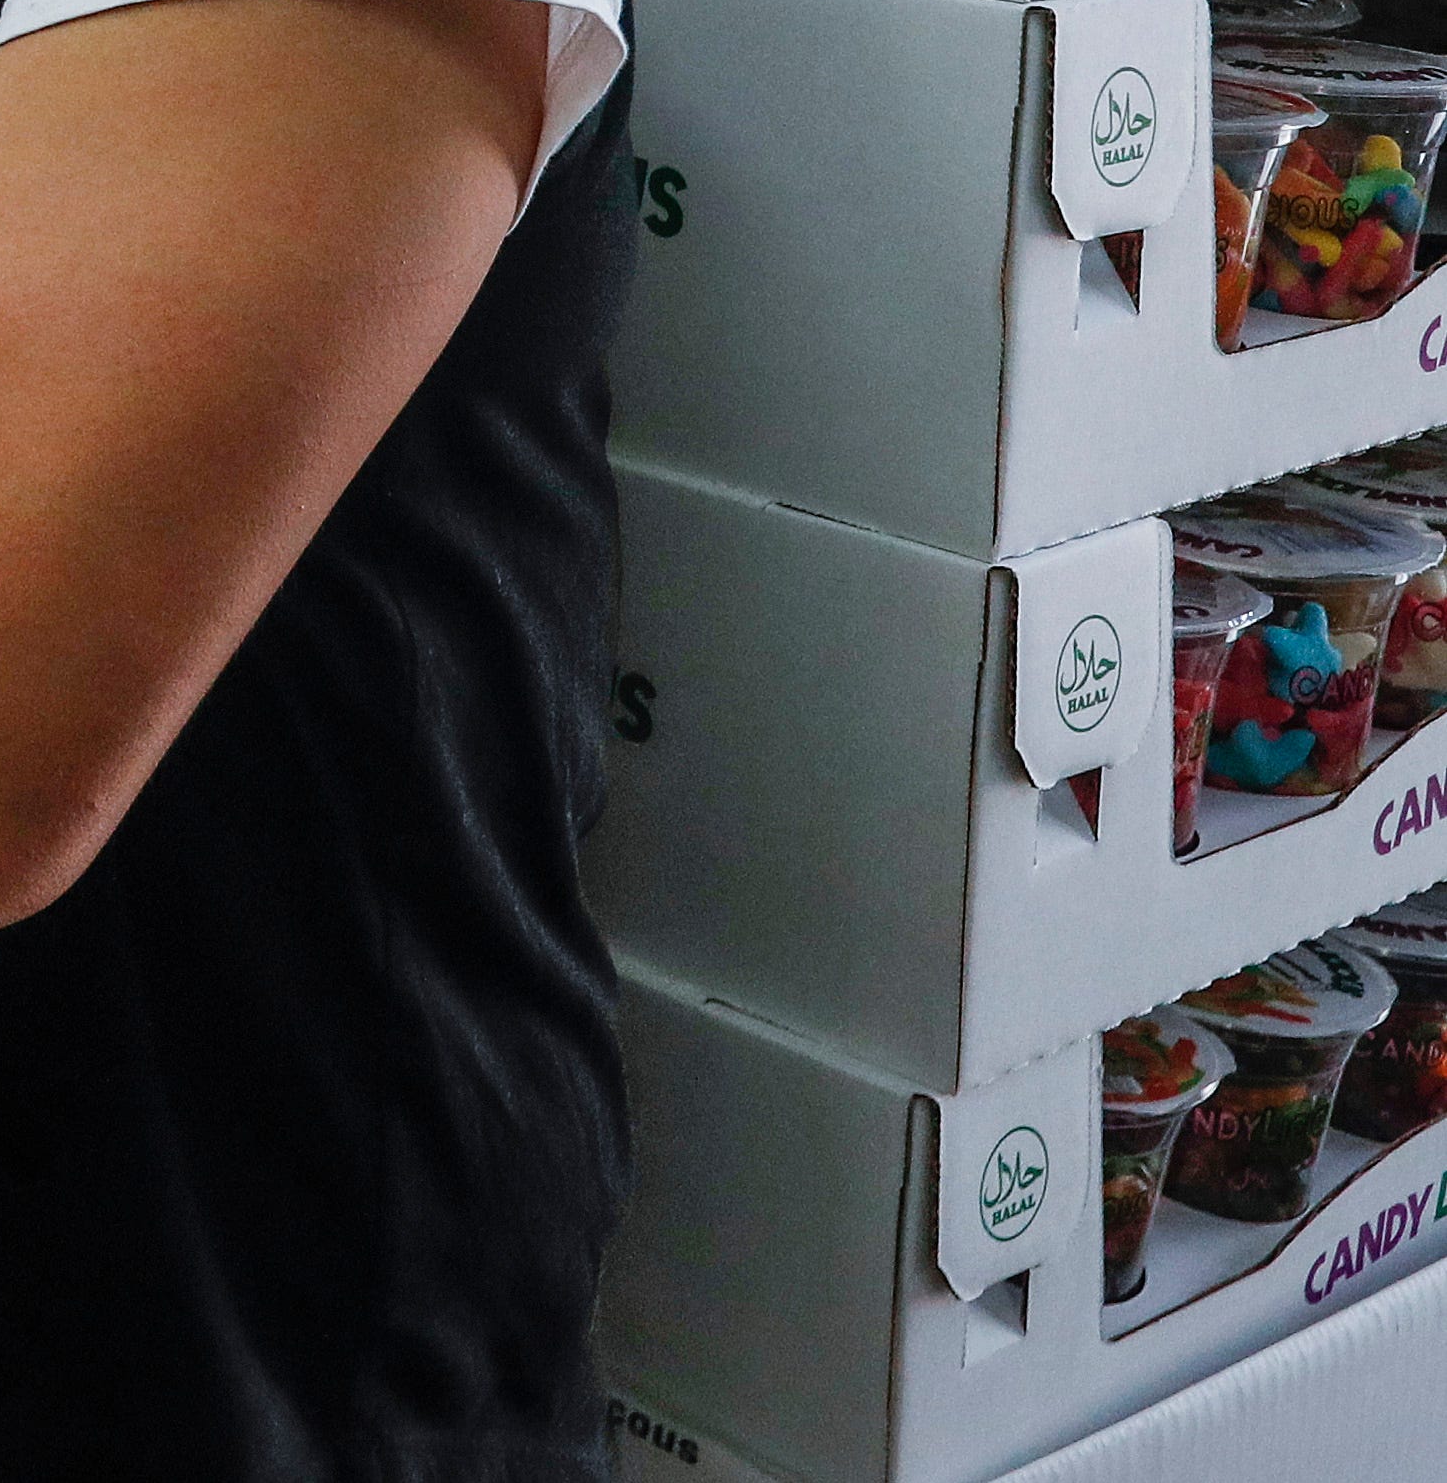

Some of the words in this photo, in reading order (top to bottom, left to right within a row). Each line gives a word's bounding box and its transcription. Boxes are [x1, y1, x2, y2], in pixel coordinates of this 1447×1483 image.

[1095, 89, 1152, 146] حلال
[1103, 143, 1144, 167] HALAL
[1060, 638, 1117, 695] حلال
[1067, 687, 1109, 715] HALAL
[1373, 767, 1447, 856] CAN
[983, 1151, 1044, 1208] حلال
[992, 1193, 1036, 1227] HALAL
[1305, 1184, 1433, 1306] CANDY
